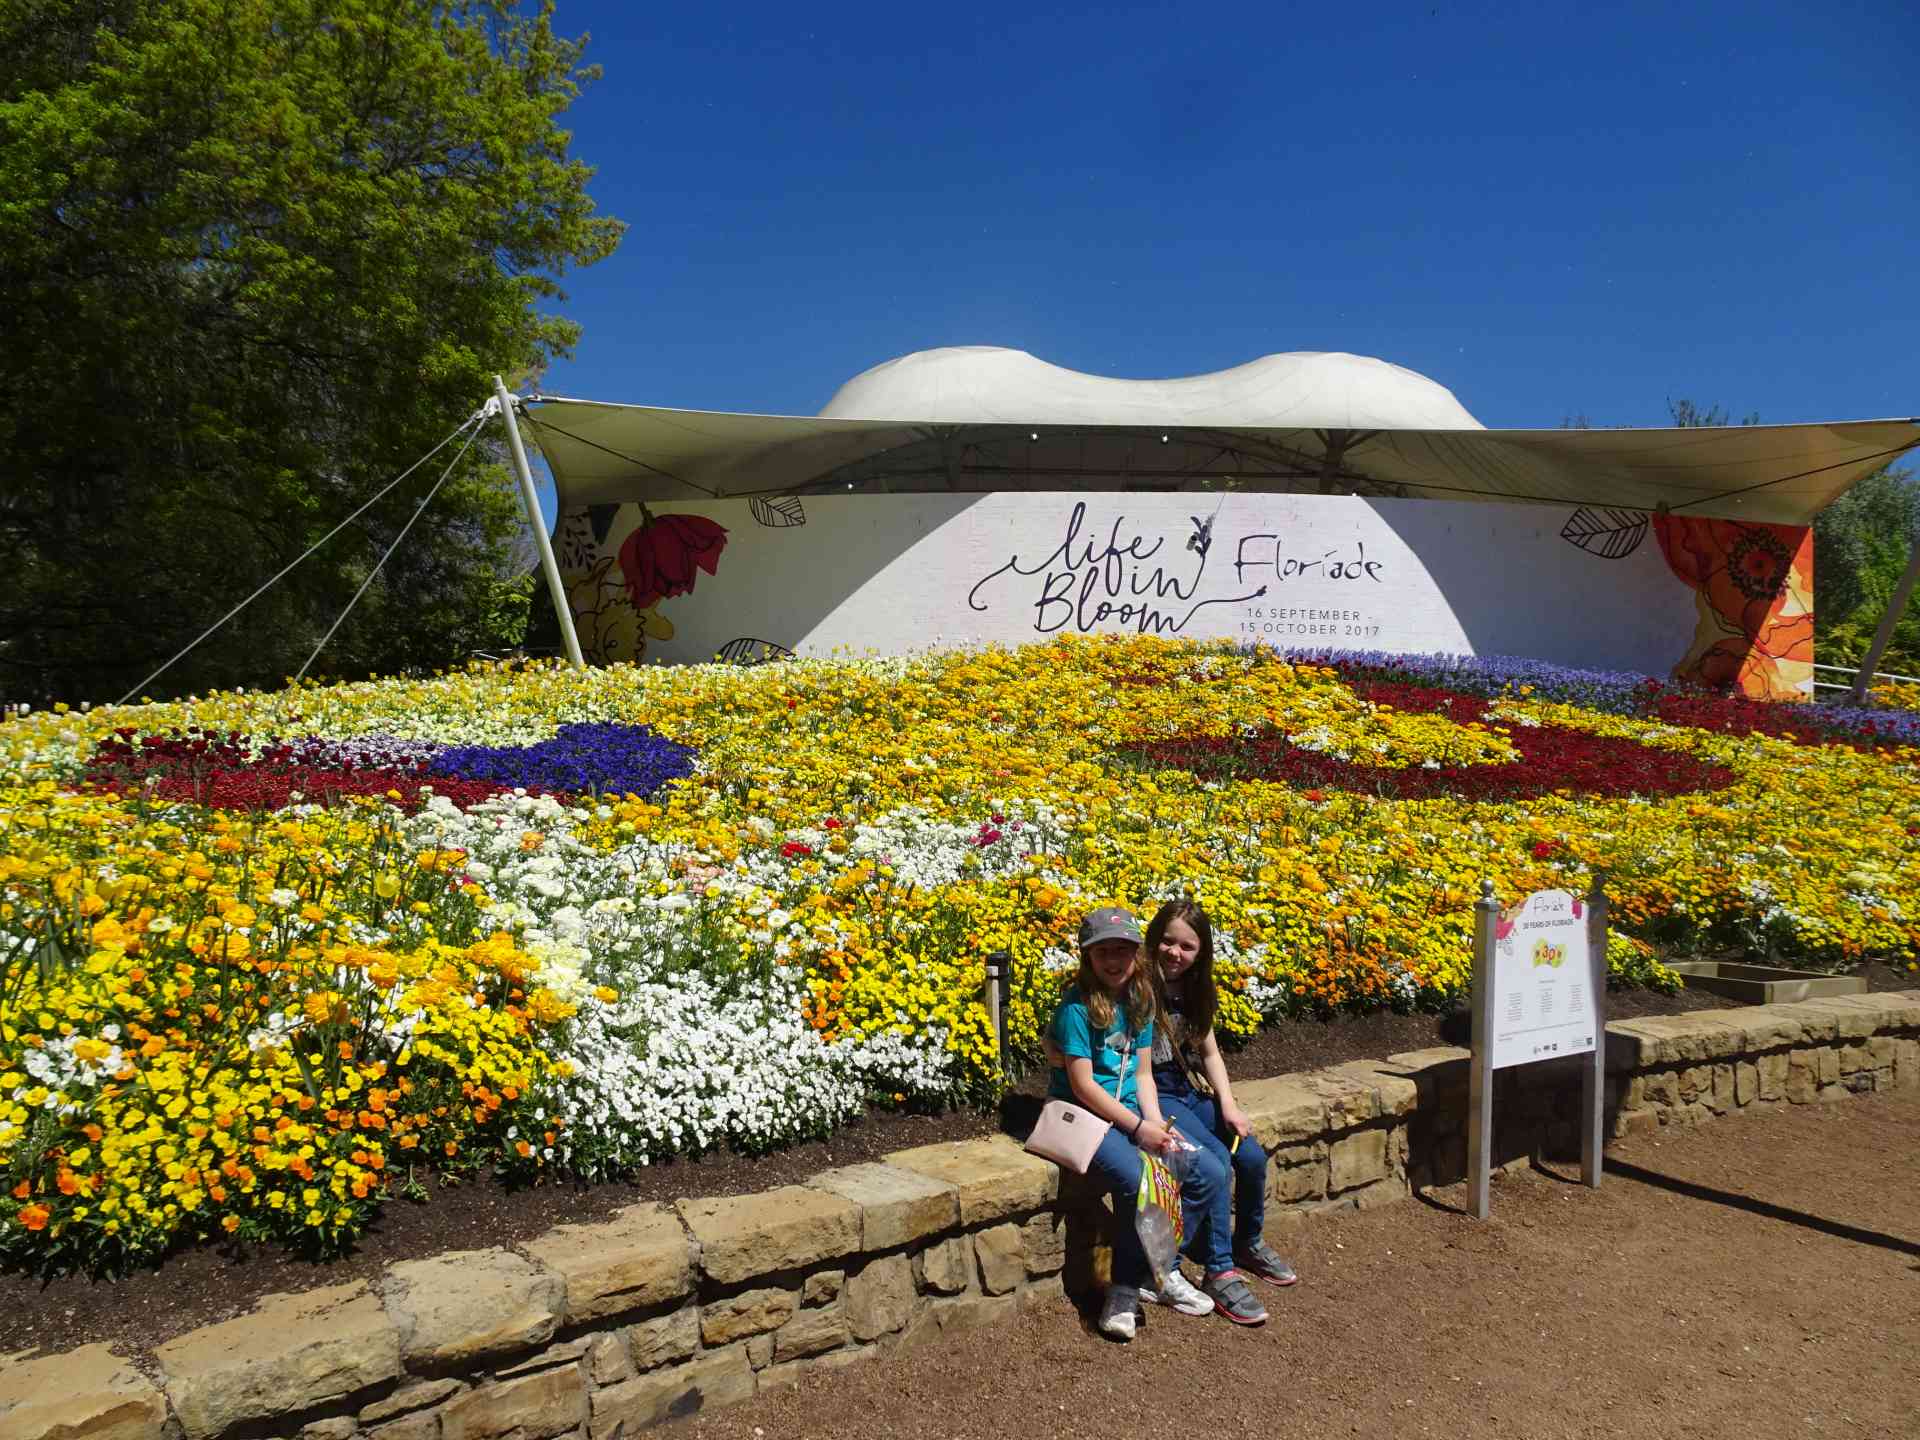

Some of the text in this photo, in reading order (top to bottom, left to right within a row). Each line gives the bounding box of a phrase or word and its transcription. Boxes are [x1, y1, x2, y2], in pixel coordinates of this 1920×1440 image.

[1005, 501, 1164, 600] life
[1234, 535, 1383, 583] Floriade
[1130, 551, 1206, 600] in
[1033, 567, 1200, 633] Bloom
[1248, 608, 1263, 618] 16
[1270, 608, 1360, 621] SEPTEMBER
[1240, 622, 1380, 636] 15 OCTOBER 2017
